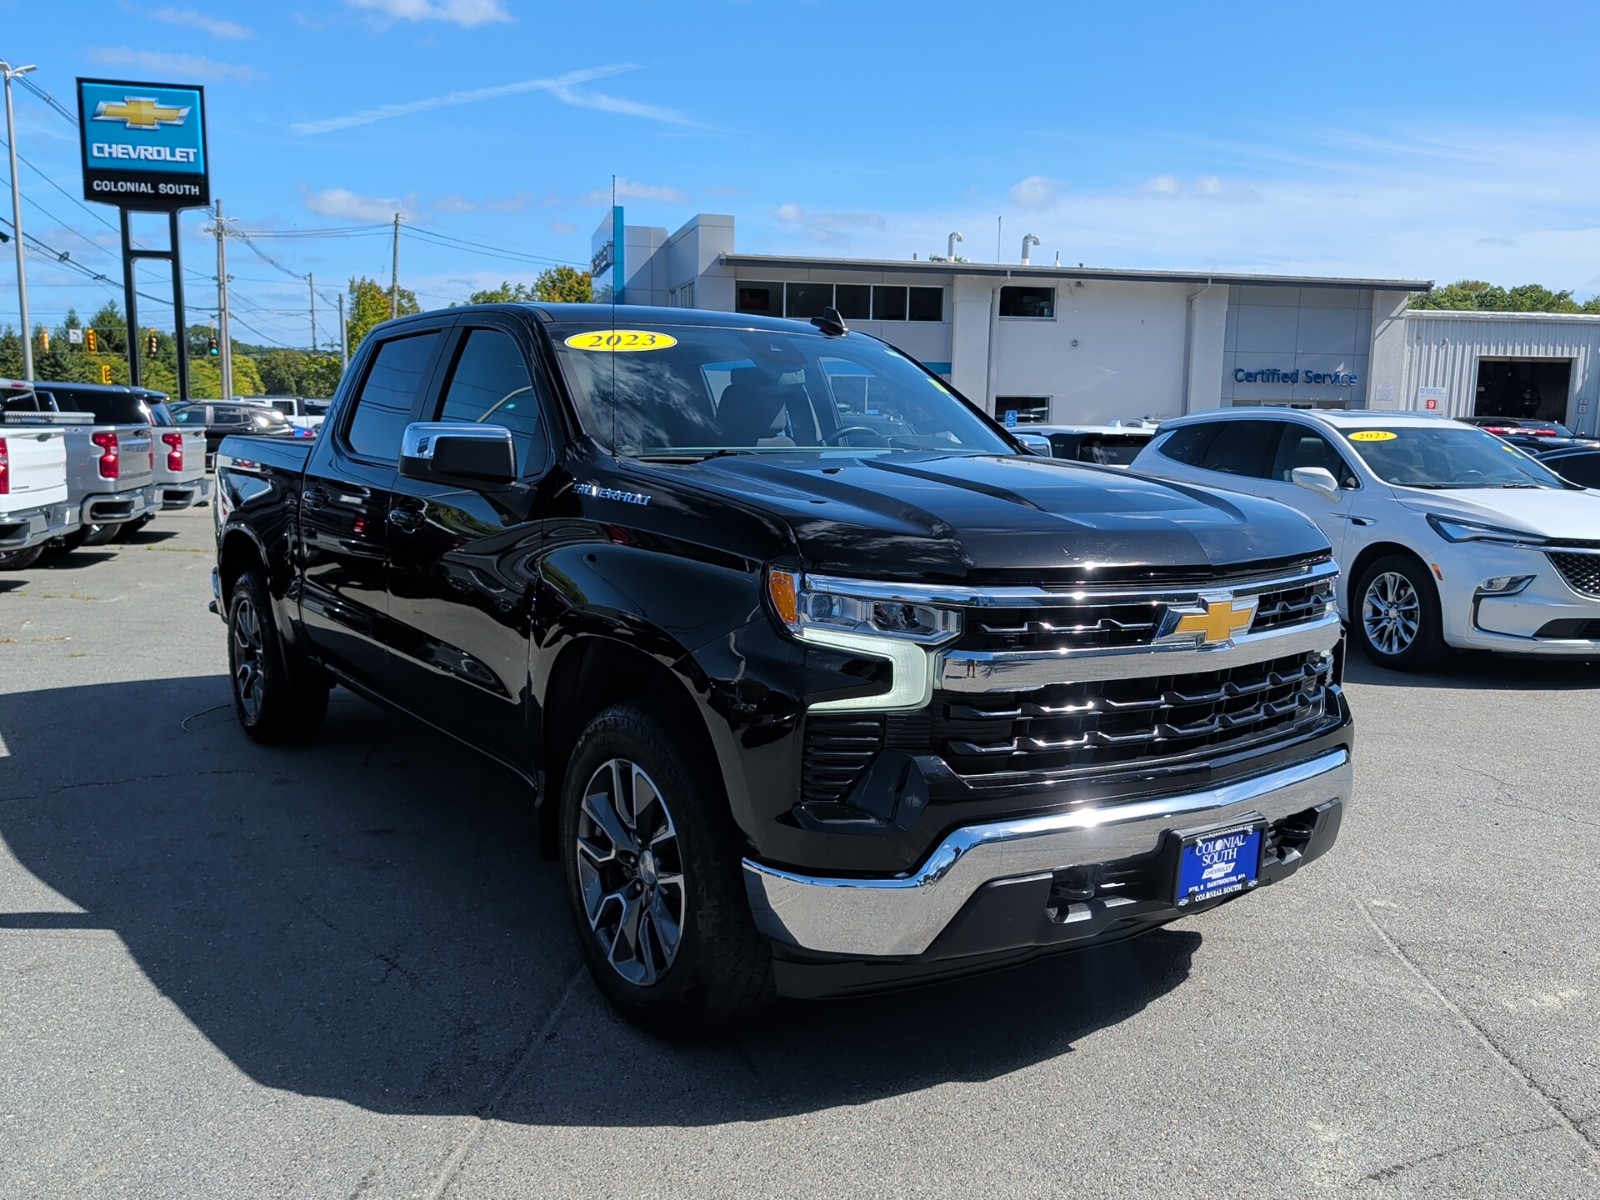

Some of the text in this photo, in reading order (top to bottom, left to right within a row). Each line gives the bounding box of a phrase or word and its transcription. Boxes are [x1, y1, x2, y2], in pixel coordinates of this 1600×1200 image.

[92, 143, 197, 162] CHEVROLET
[93, 180, 200, 195] COLONIAL SOUTH
[589, 334, 656, 347] 2023
[1234, 369, 1358, 386] Certified Service
[1428, 400, 1435, 408] 9
[573, 484, 651, 505] SILVERADO
[1195, 835, 1246, 856] COLONIAL
[1202, 848, 1237, 866] SOUTH
[1205, 864, 1233, 876] CHEVROLET
[1194, 883, 1243, 902] COLONIAL SOUTH
